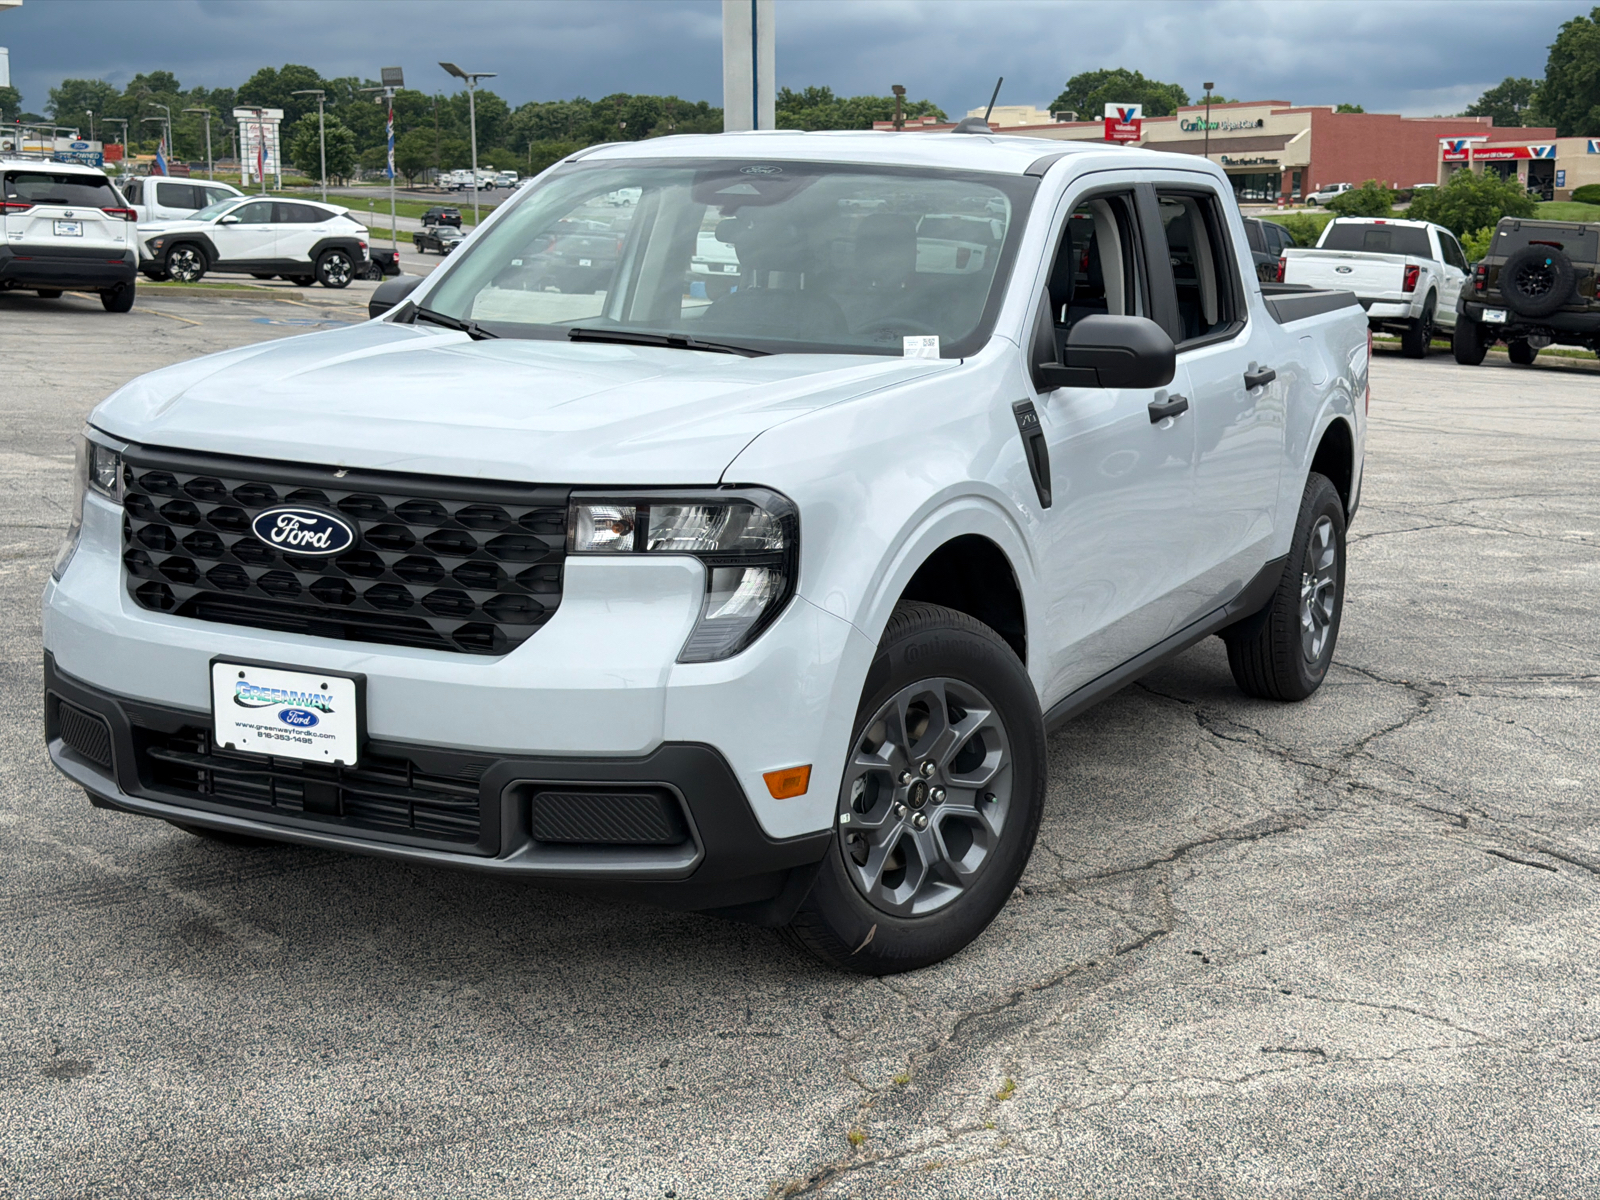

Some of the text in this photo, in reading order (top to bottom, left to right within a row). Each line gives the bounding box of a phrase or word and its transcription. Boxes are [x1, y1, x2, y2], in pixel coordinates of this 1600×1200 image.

[271, 514, 333, 548] Ford
[235, 681, 333, 709] GREENWAY
[286, 710, 311, 725] Ford
[234, 721, 336, 740] www.greenwayfordkc.com
[257, 731, 313, 744] 816-353-1495
